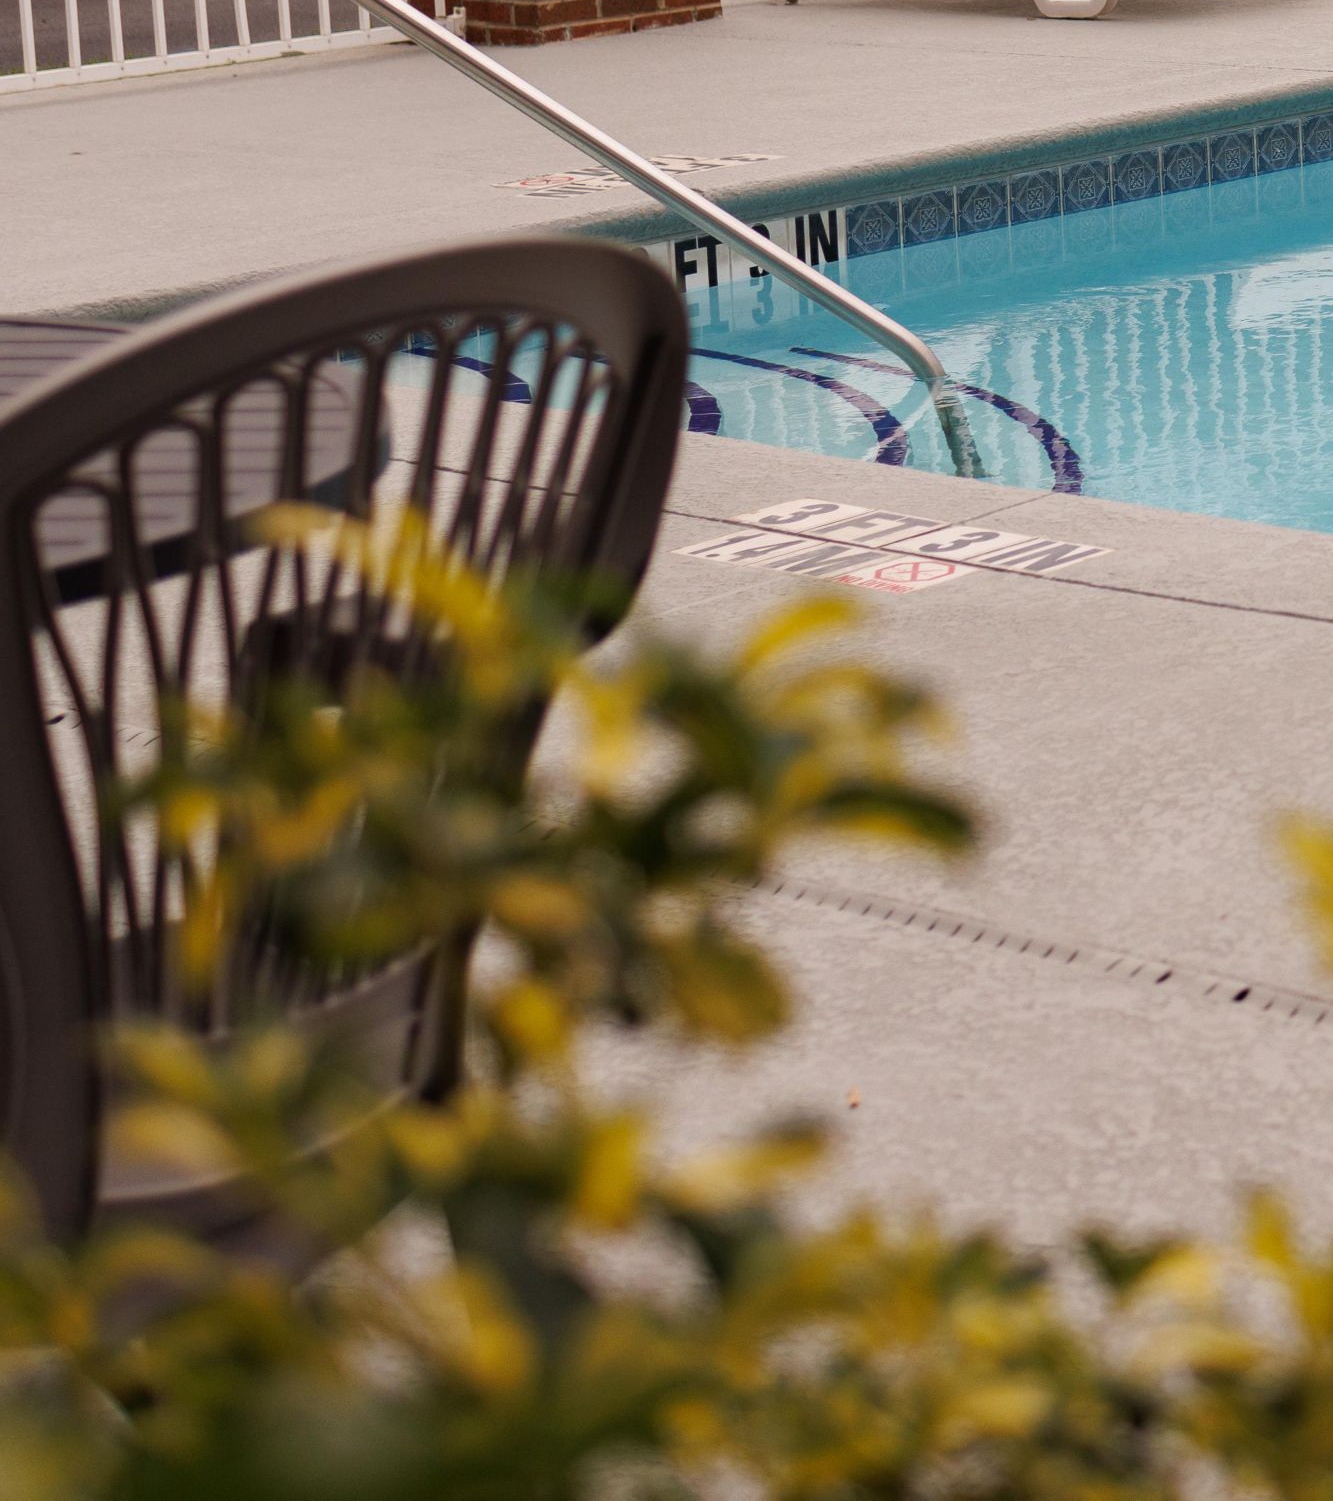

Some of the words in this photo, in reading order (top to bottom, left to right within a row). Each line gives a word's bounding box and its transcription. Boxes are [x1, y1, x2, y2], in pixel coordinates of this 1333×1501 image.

[674, 235, 723, 293] FT
[795, 209, 839, 267] IN
[757, 503, 841, 525] 3
[810, 510, 940, 544] FT
[918, 531, 1001, 554] 3
[978, 539, 1101, 572] IN
[766, 545, 892, 578] M
